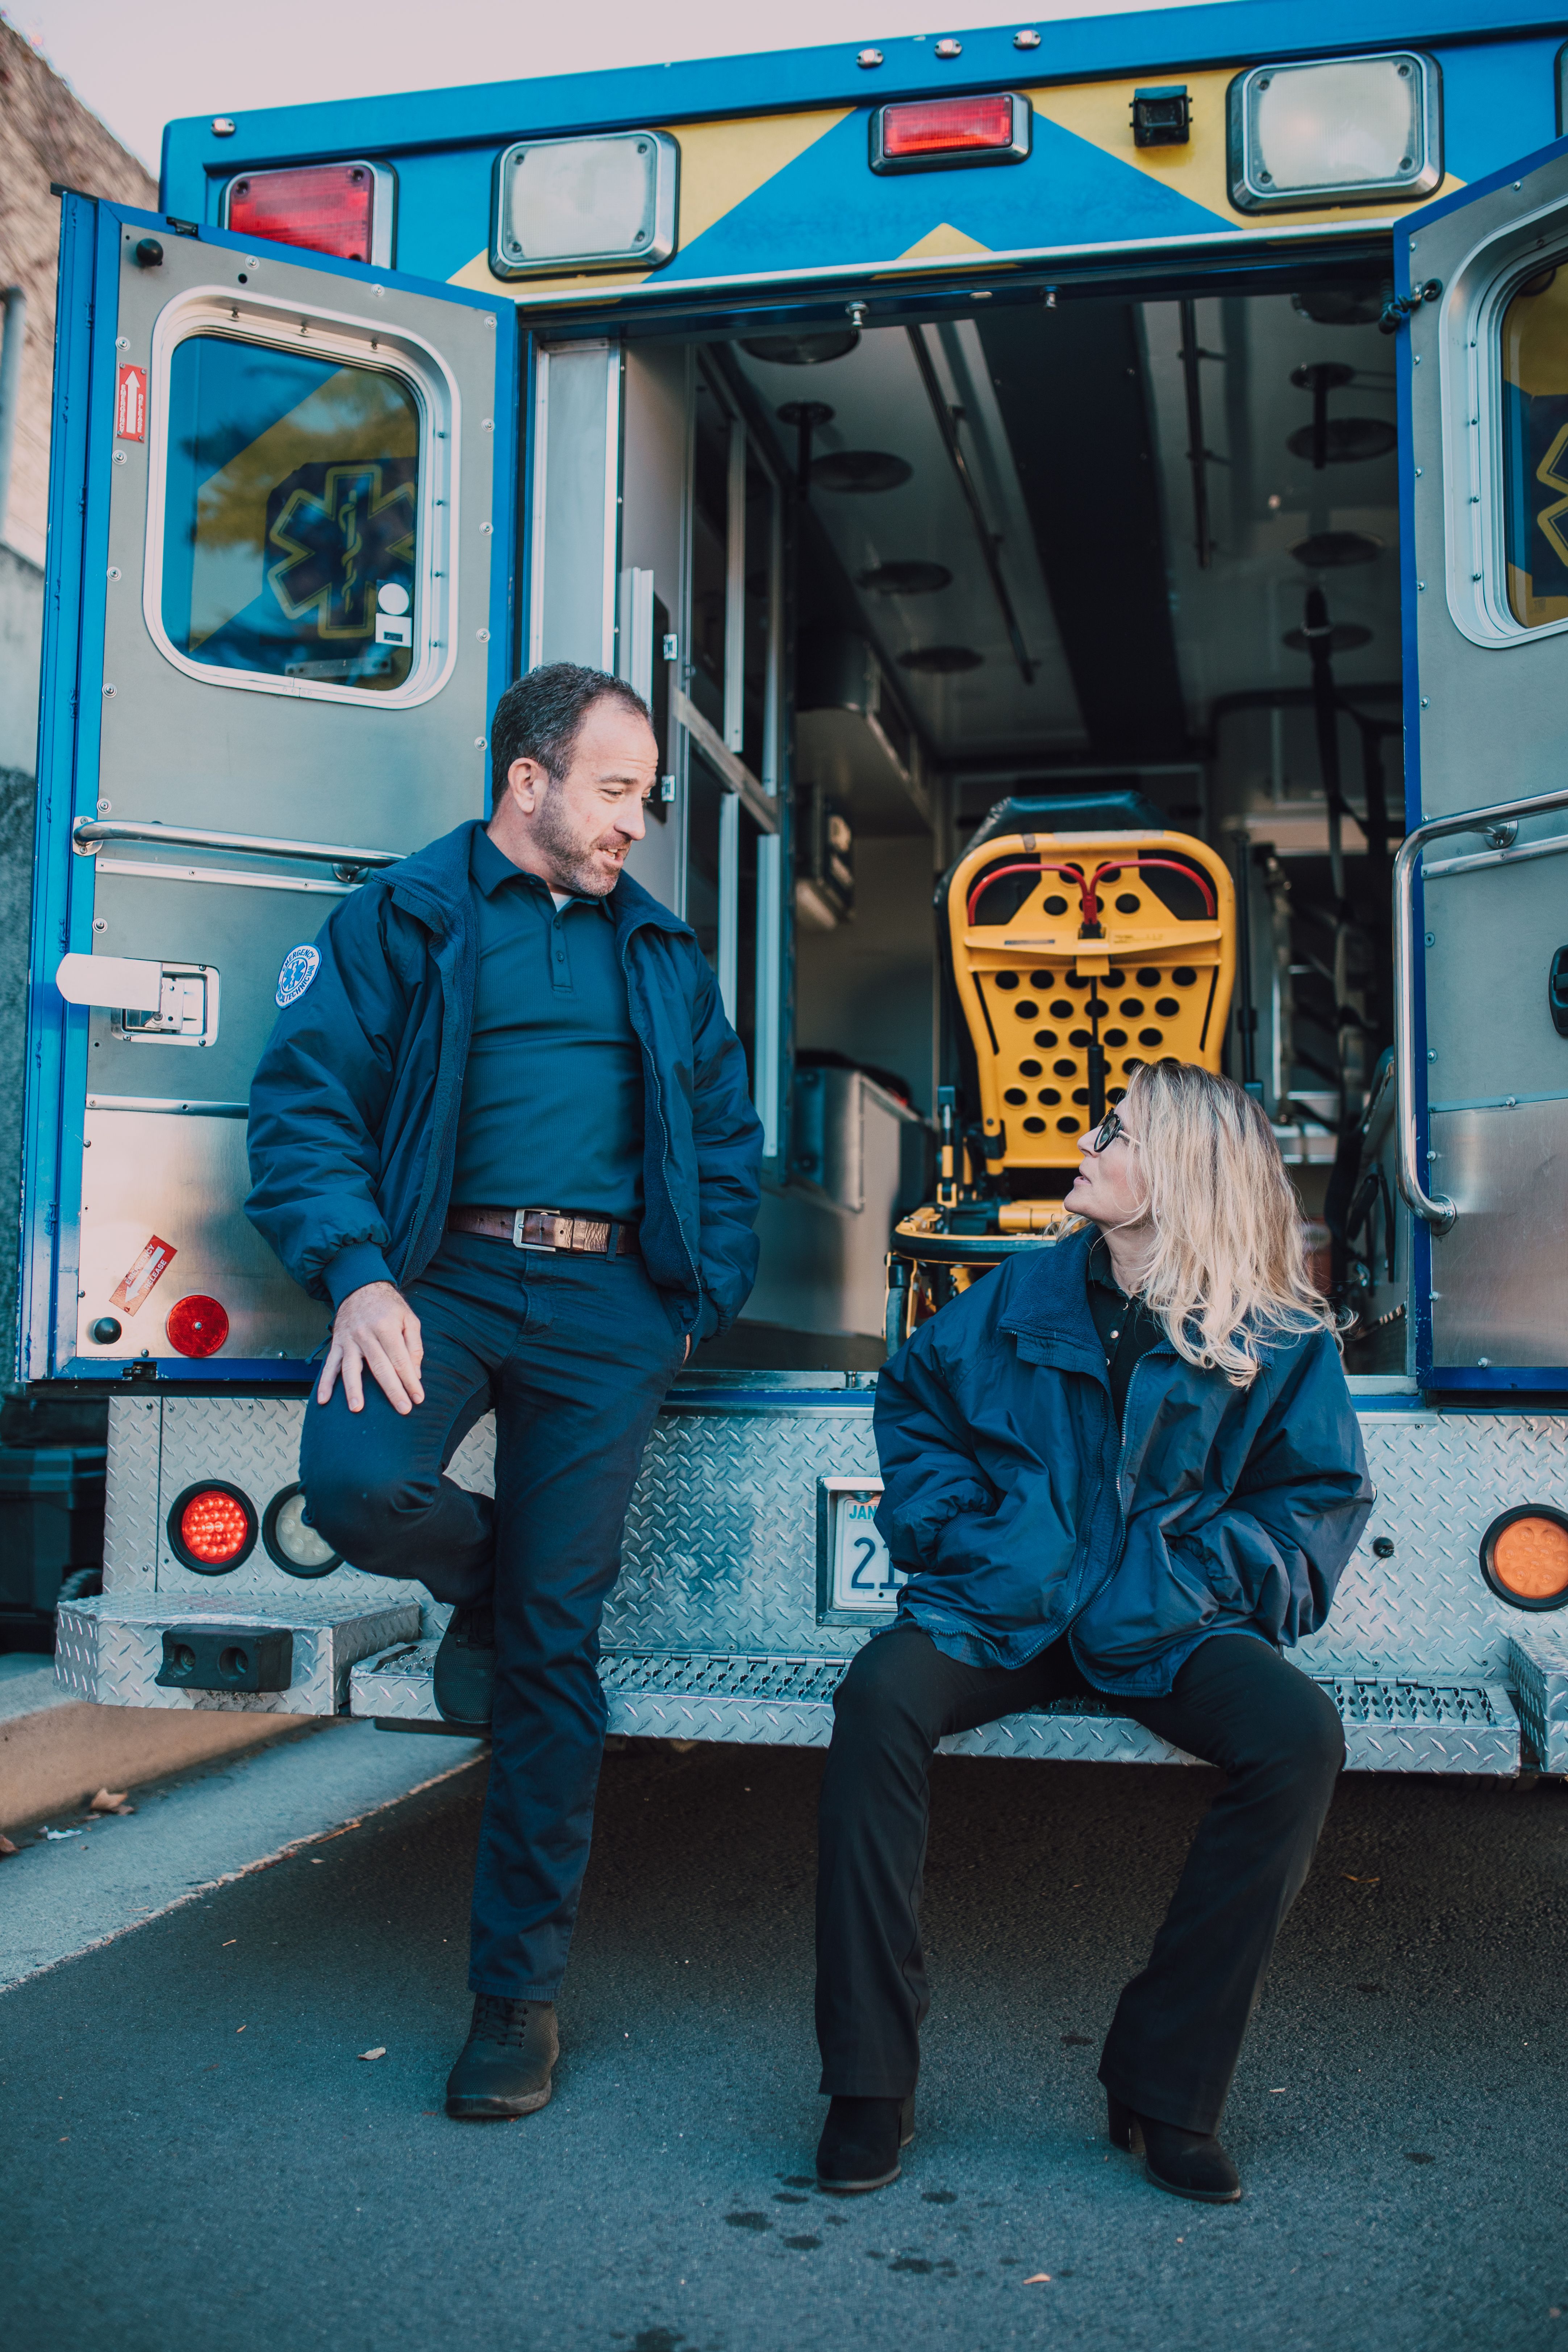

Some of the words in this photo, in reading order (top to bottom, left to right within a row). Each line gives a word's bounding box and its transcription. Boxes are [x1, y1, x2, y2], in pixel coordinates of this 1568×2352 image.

[283, 949, 315, 972] EMERGENCY
[285, 964, 315, 1003] TECHNICIAN
[125, 1243, 155, 1285] EMERGENCY
[143, 1259, 167, 1290] RELEASE
[849, 1505, 877, 1519] JAN
